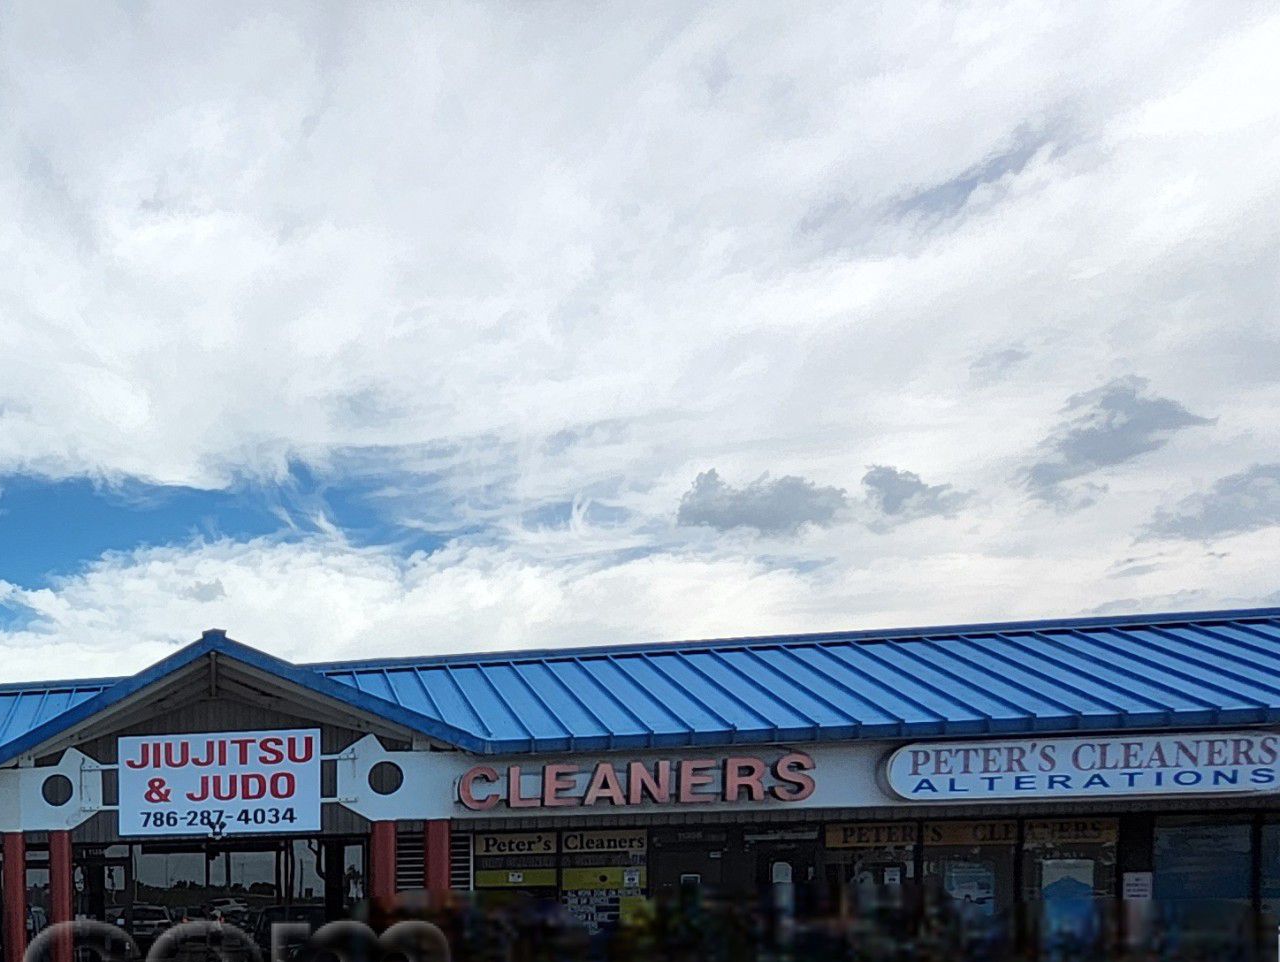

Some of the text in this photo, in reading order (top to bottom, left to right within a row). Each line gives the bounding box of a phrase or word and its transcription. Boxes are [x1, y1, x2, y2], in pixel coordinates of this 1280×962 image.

[126, 736, 313, 769] JIUJITSU
[908, 737, 1278, 776] PETER'S CLEANERS
[144, 771, 296, 803] & JUDO
[457, 752, 816, 811] CLEANERS
[911, 768, 1276, 793] ALTERATIONS
[139, 807, 298, 828] 786-287-4034
[483, 833, 645, 853] Peter's Cleaners
